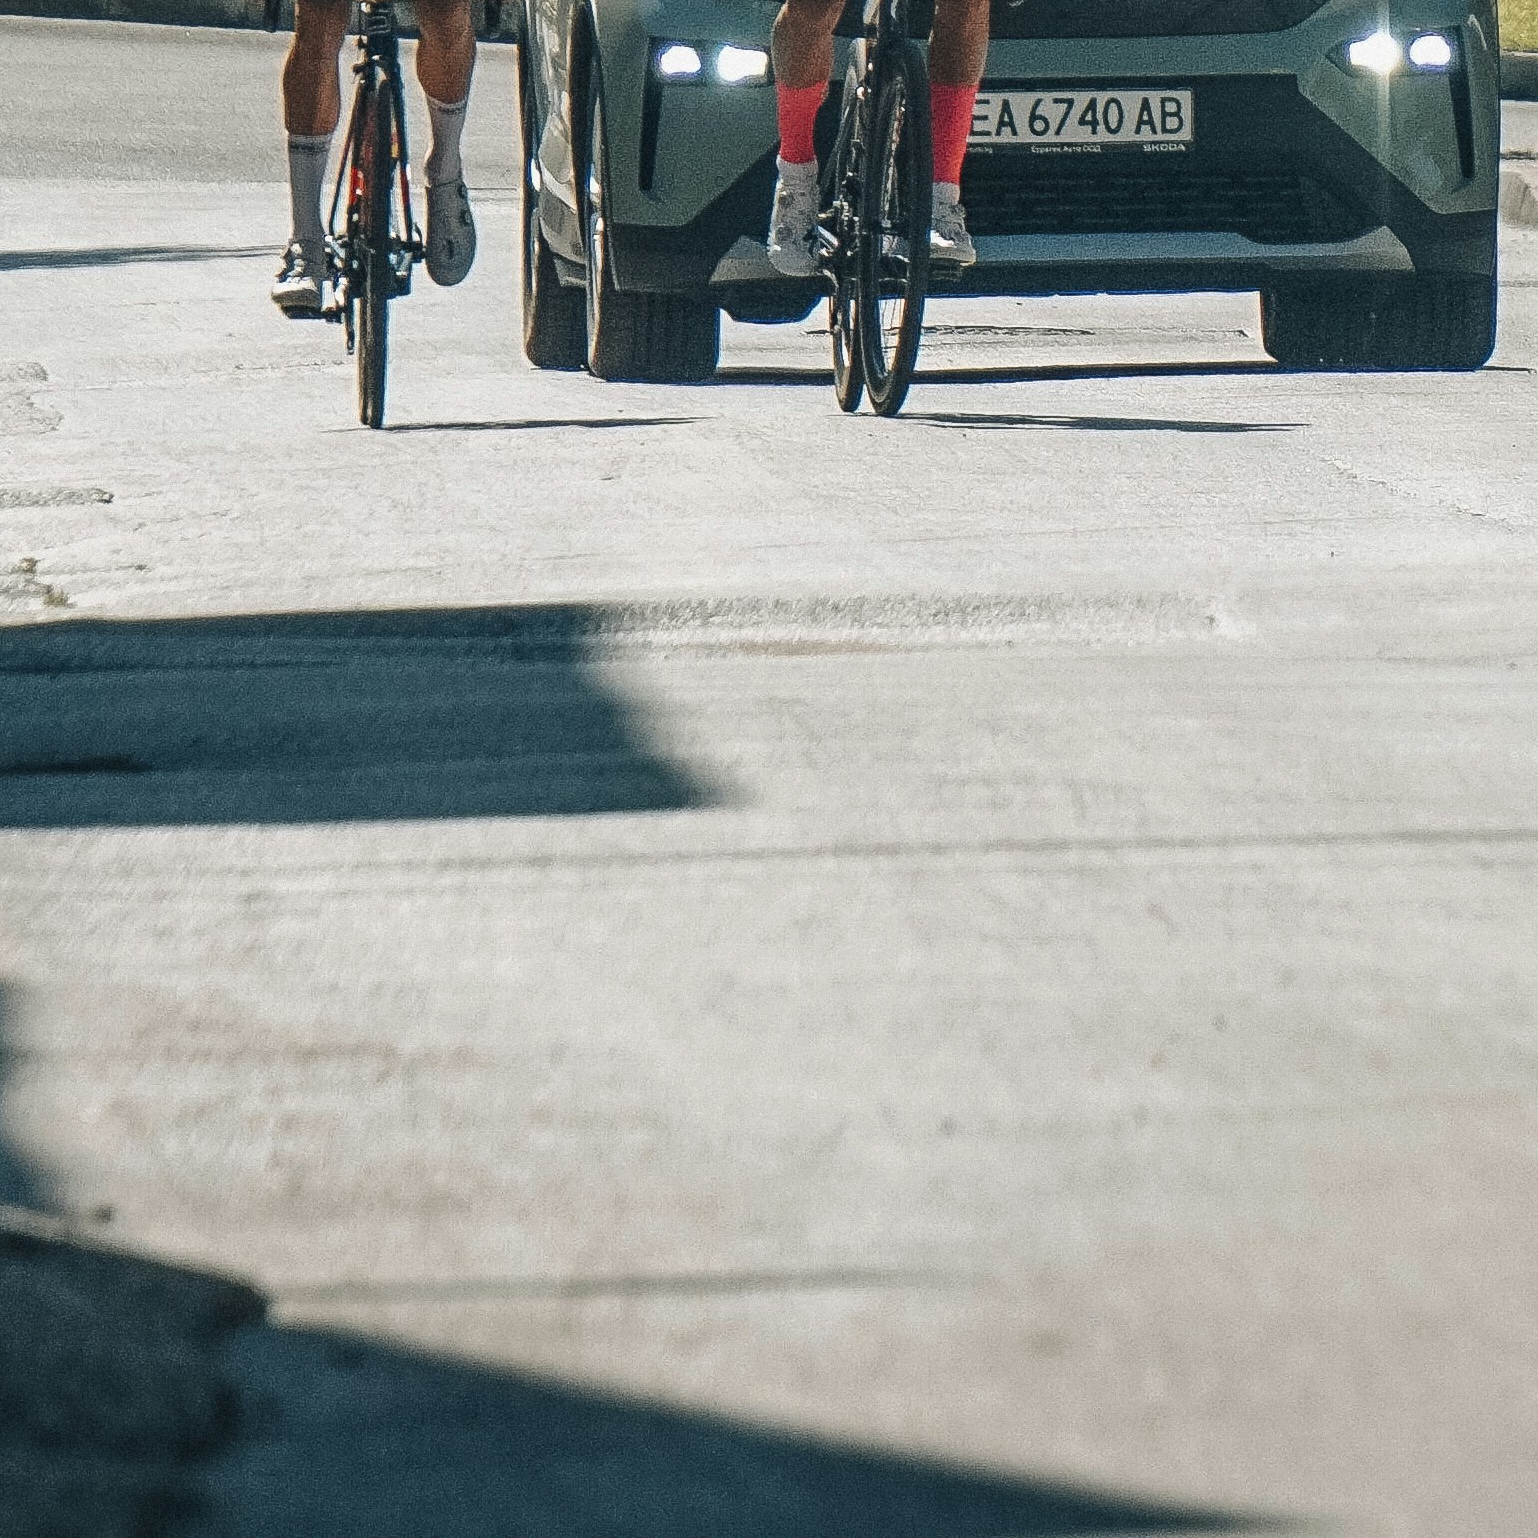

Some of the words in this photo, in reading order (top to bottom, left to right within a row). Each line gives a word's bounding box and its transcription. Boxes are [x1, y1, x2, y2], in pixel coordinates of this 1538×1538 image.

[968, 97, 1018, 137] EA
[1028, 96, 1125, 137] 6740
[1134, 96, 1185, 135] AB
